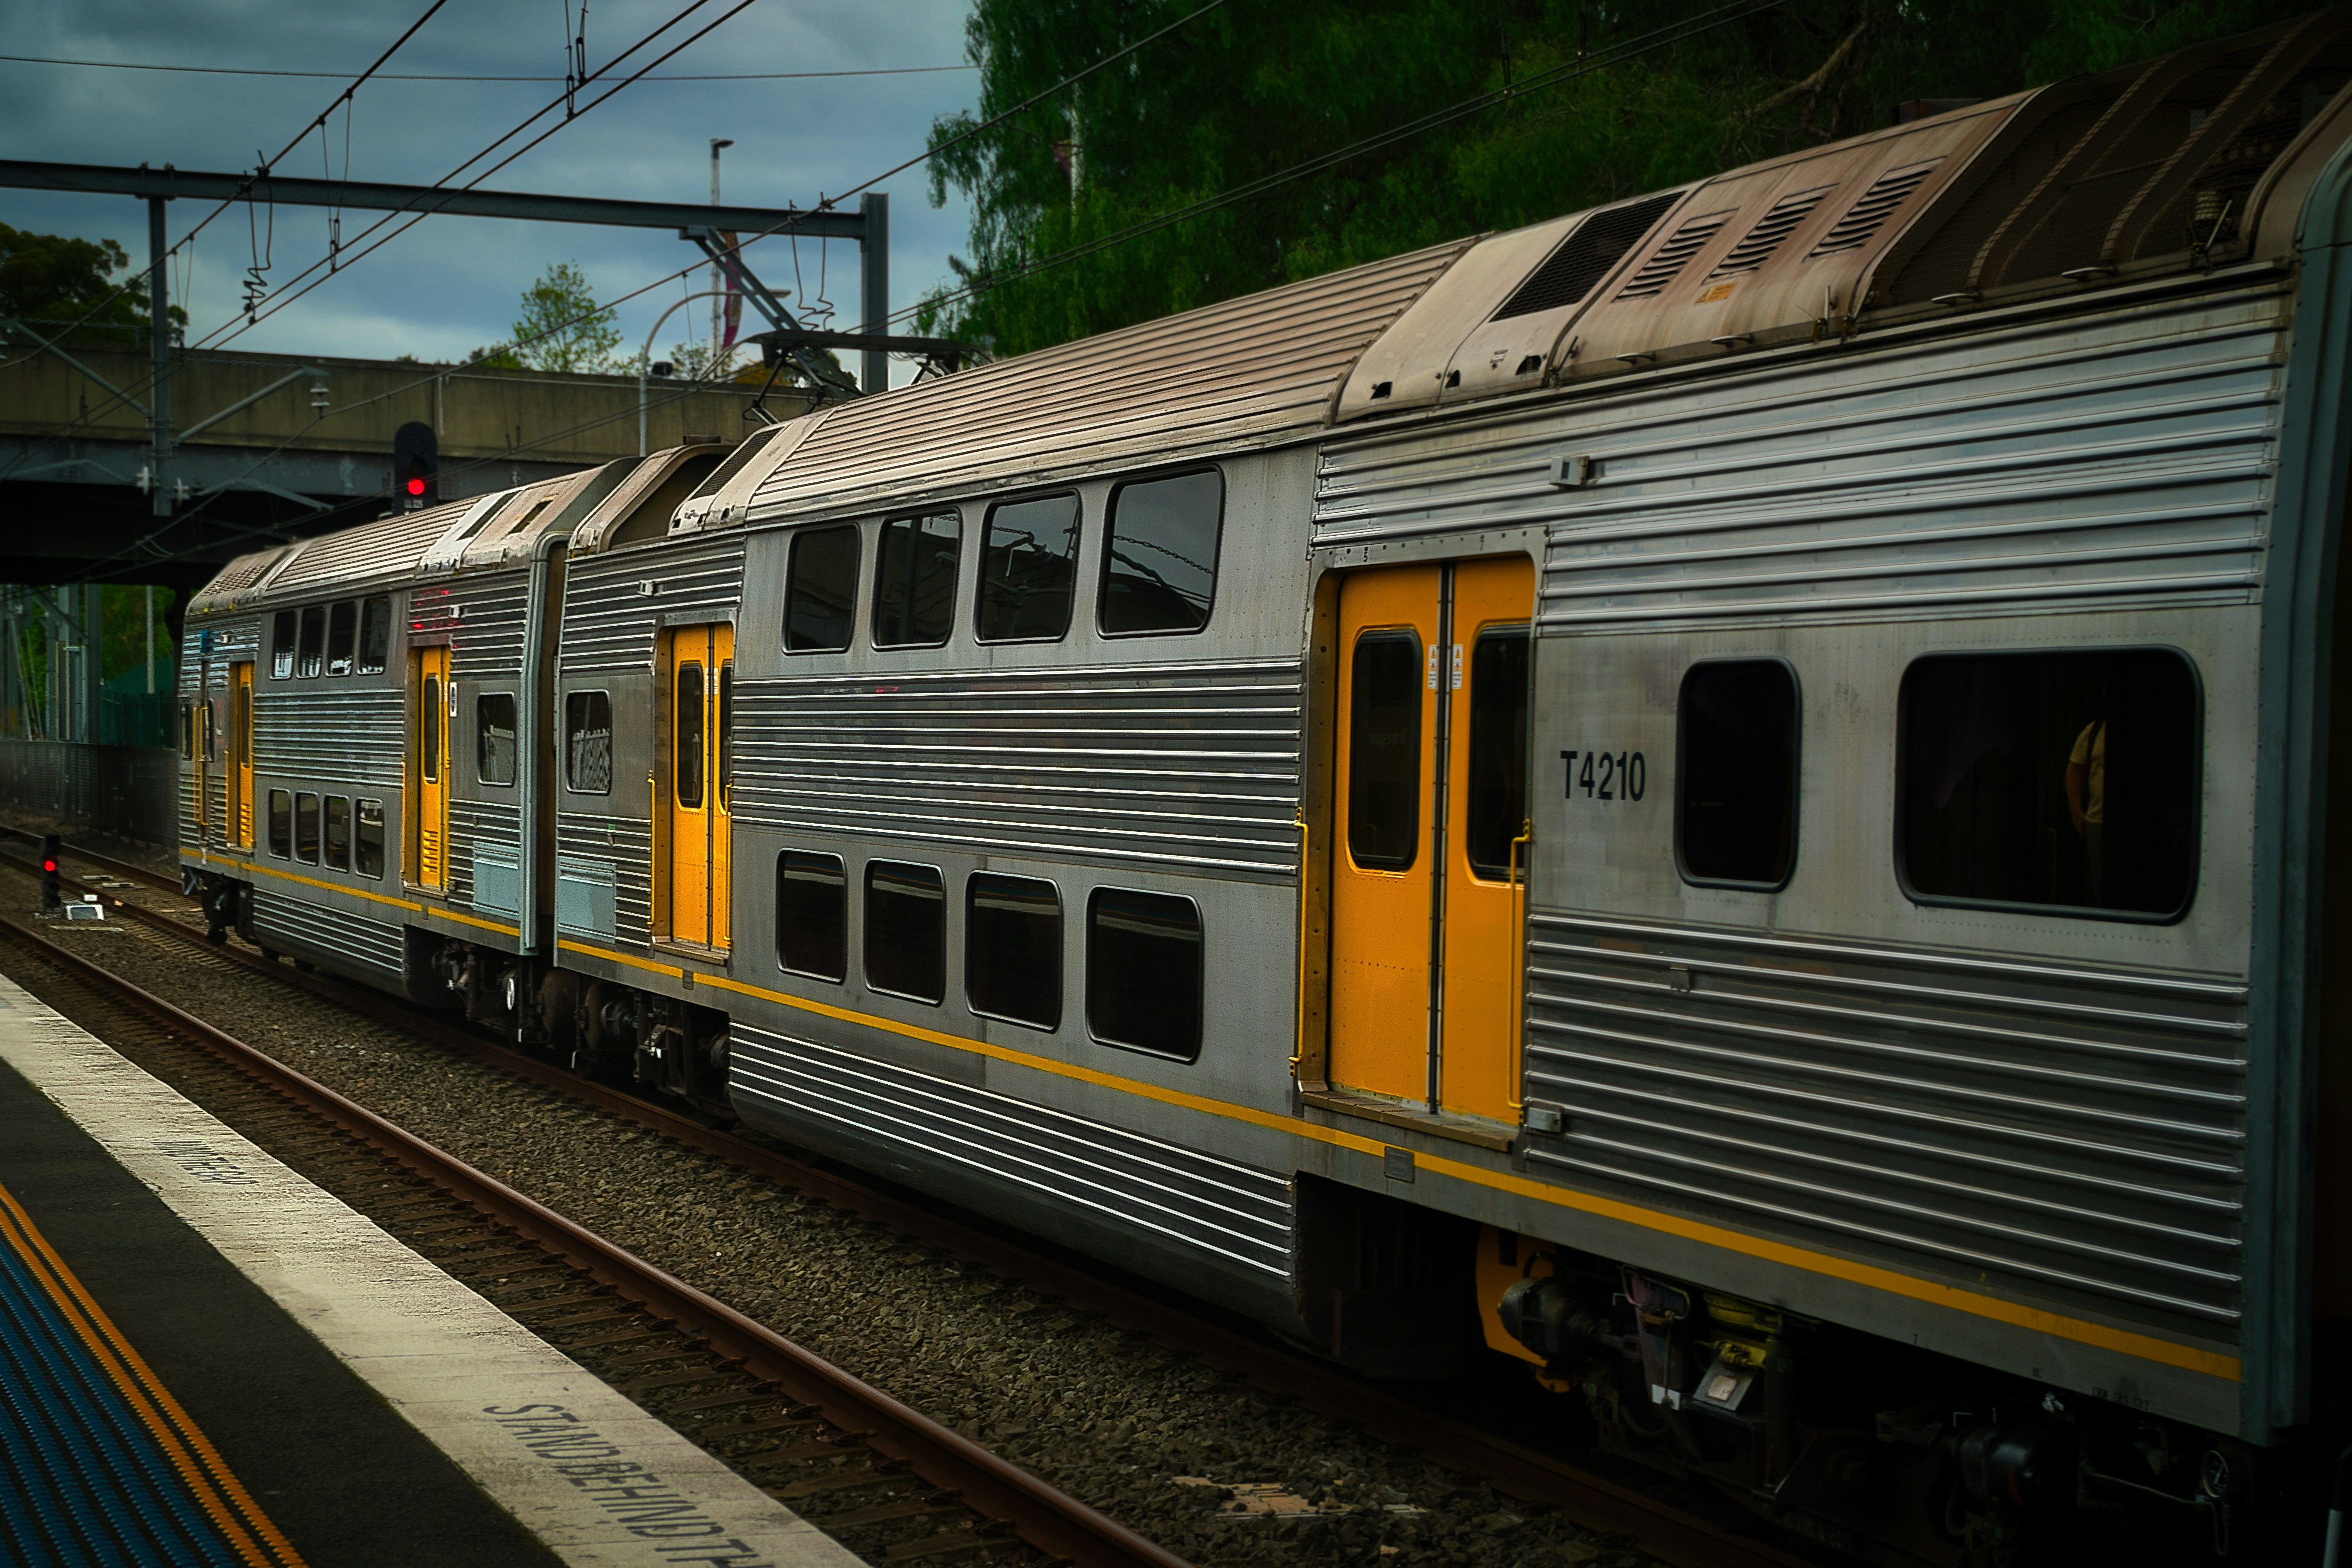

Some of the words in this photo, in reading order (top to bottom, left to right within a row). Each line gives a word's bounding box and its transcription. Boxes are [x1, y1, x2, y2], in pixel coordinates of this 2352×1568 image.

[1560, 750, 1646, 801] T4210
[151, 1141, 219, 1158] MIND
[173, 1157, 240, 1171] THE
[190, 1171, 259, 1185] GAP
[483, 1404, 621, 1460] STAND
[556, 1462, 725, 1538] BEHIND
